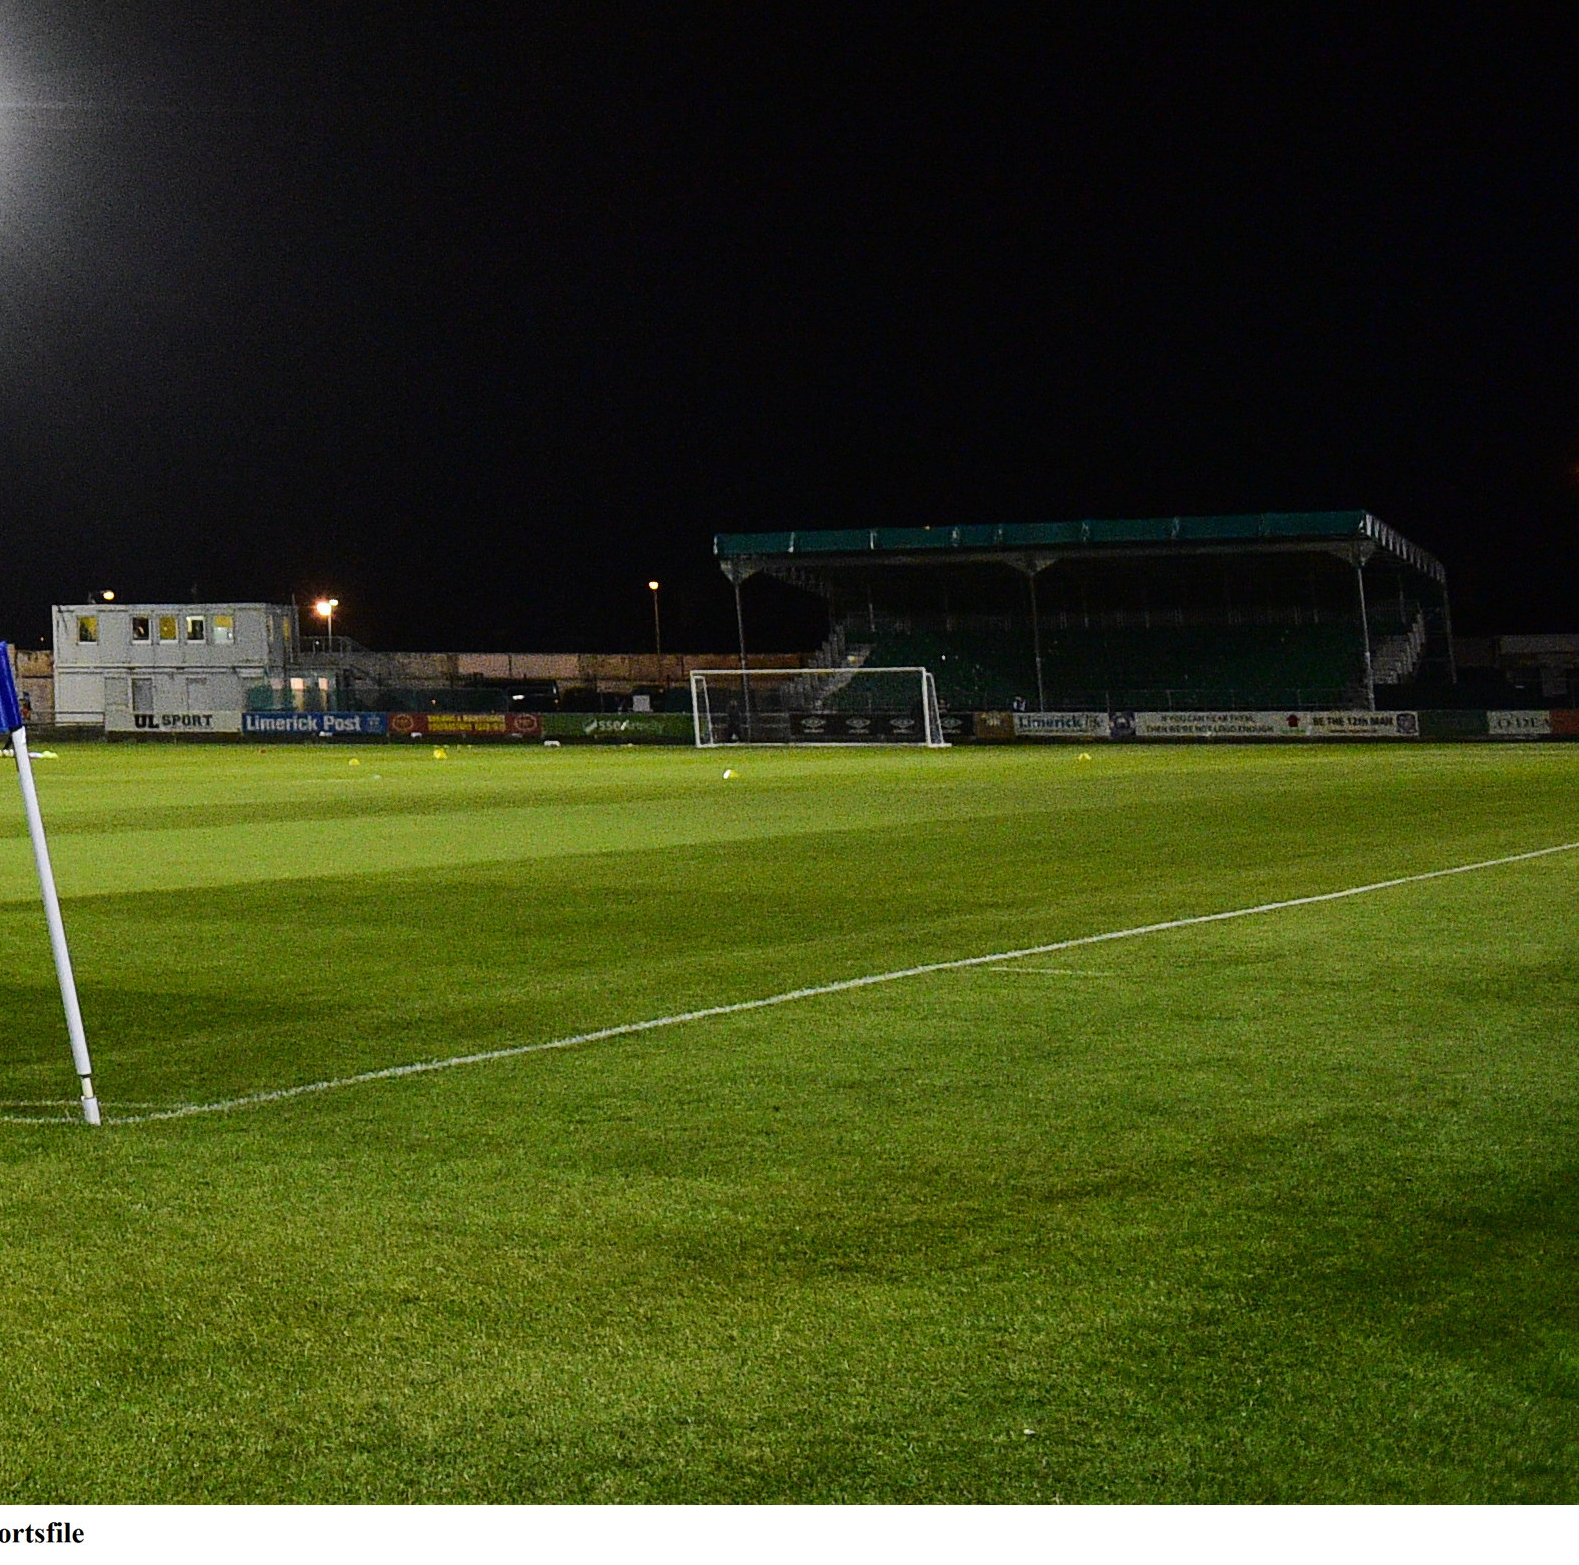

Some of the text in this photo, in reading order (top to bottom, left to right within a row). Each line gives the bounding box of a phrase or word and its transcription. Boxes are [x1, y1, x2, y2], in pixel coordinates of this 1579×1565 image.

[134, 714, 213, 729] UL SPORT
[245, 715, 362, 732] Limerick Post
